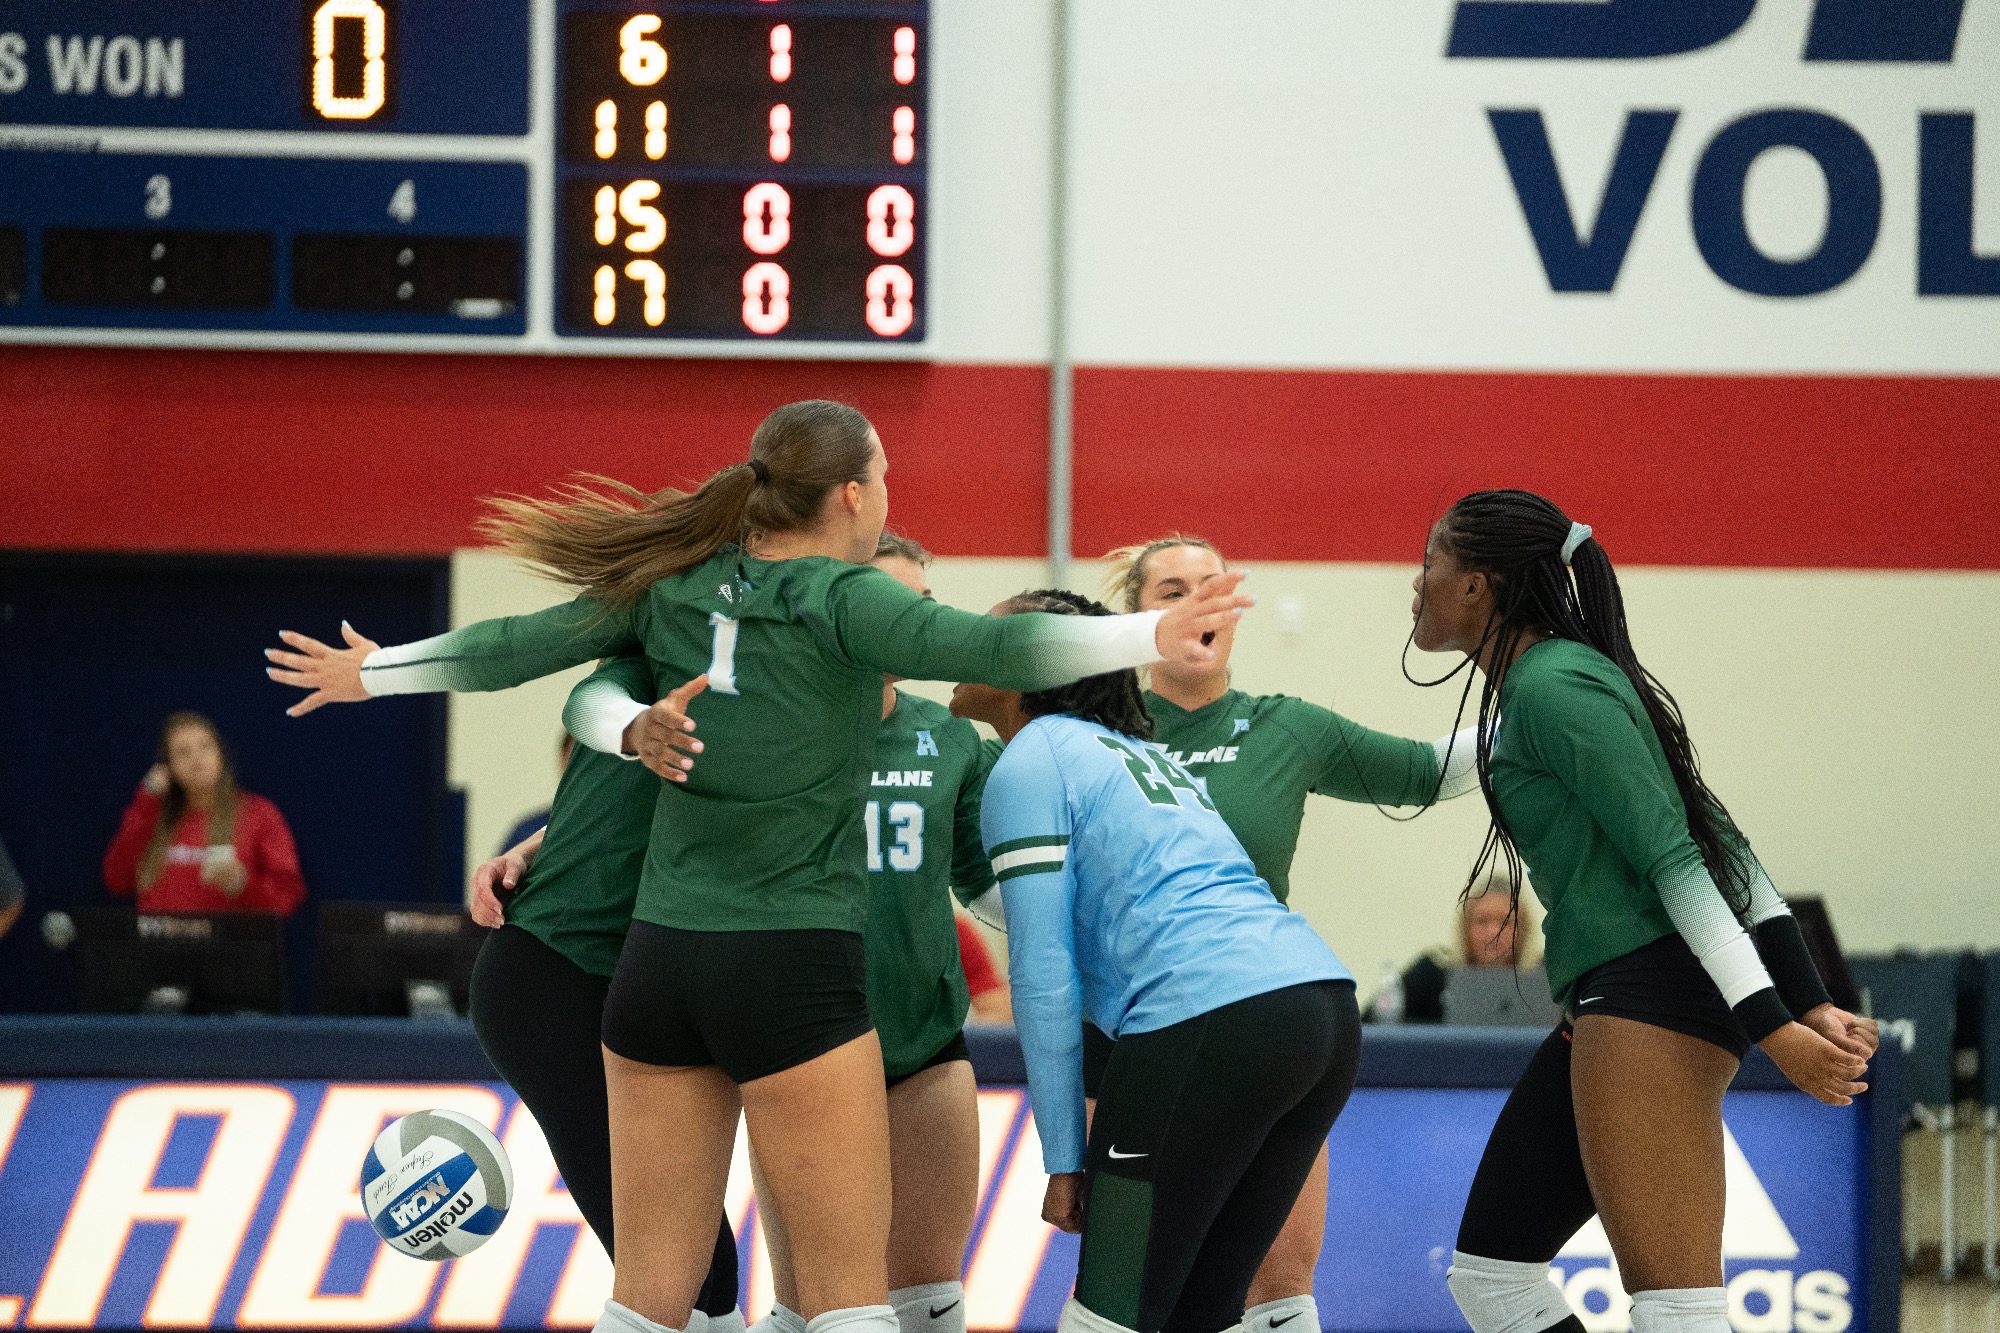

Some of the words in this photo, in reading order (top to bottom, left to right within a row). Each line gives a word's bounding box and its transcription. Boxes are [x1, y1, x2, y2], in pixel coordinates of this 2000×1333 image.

[47, 35, 184, 97] WON
[313, 0, 386, 119] 0
[620, 14, 667, 86] 6
[769, 24, 792, 83] 1
[893, 26, 916, 85] 1
[594, 99, 667, 160] 11
[768, 104, 792, 163] 1
[892, 106, 915, 164] 1
[144, 174, 172, 219] 3
[386, 179, 416, 223] 4
[594, 179, 667, 253] 15
[743, 182, 790, 255] 0
[866, 184, 914, 257] 0
[594, 259, 666, 326] 17
[742, 262, 789, 335] 0
[866, 264, 913, 337] 0
[706, 611, 741, 696] 1
[1093, 733, 1219, 814] 24
[864, 800, 925, 872] 13
[388, 1174, 451, 1230] NCAA
[402, 1191, 474, 1248] molten
